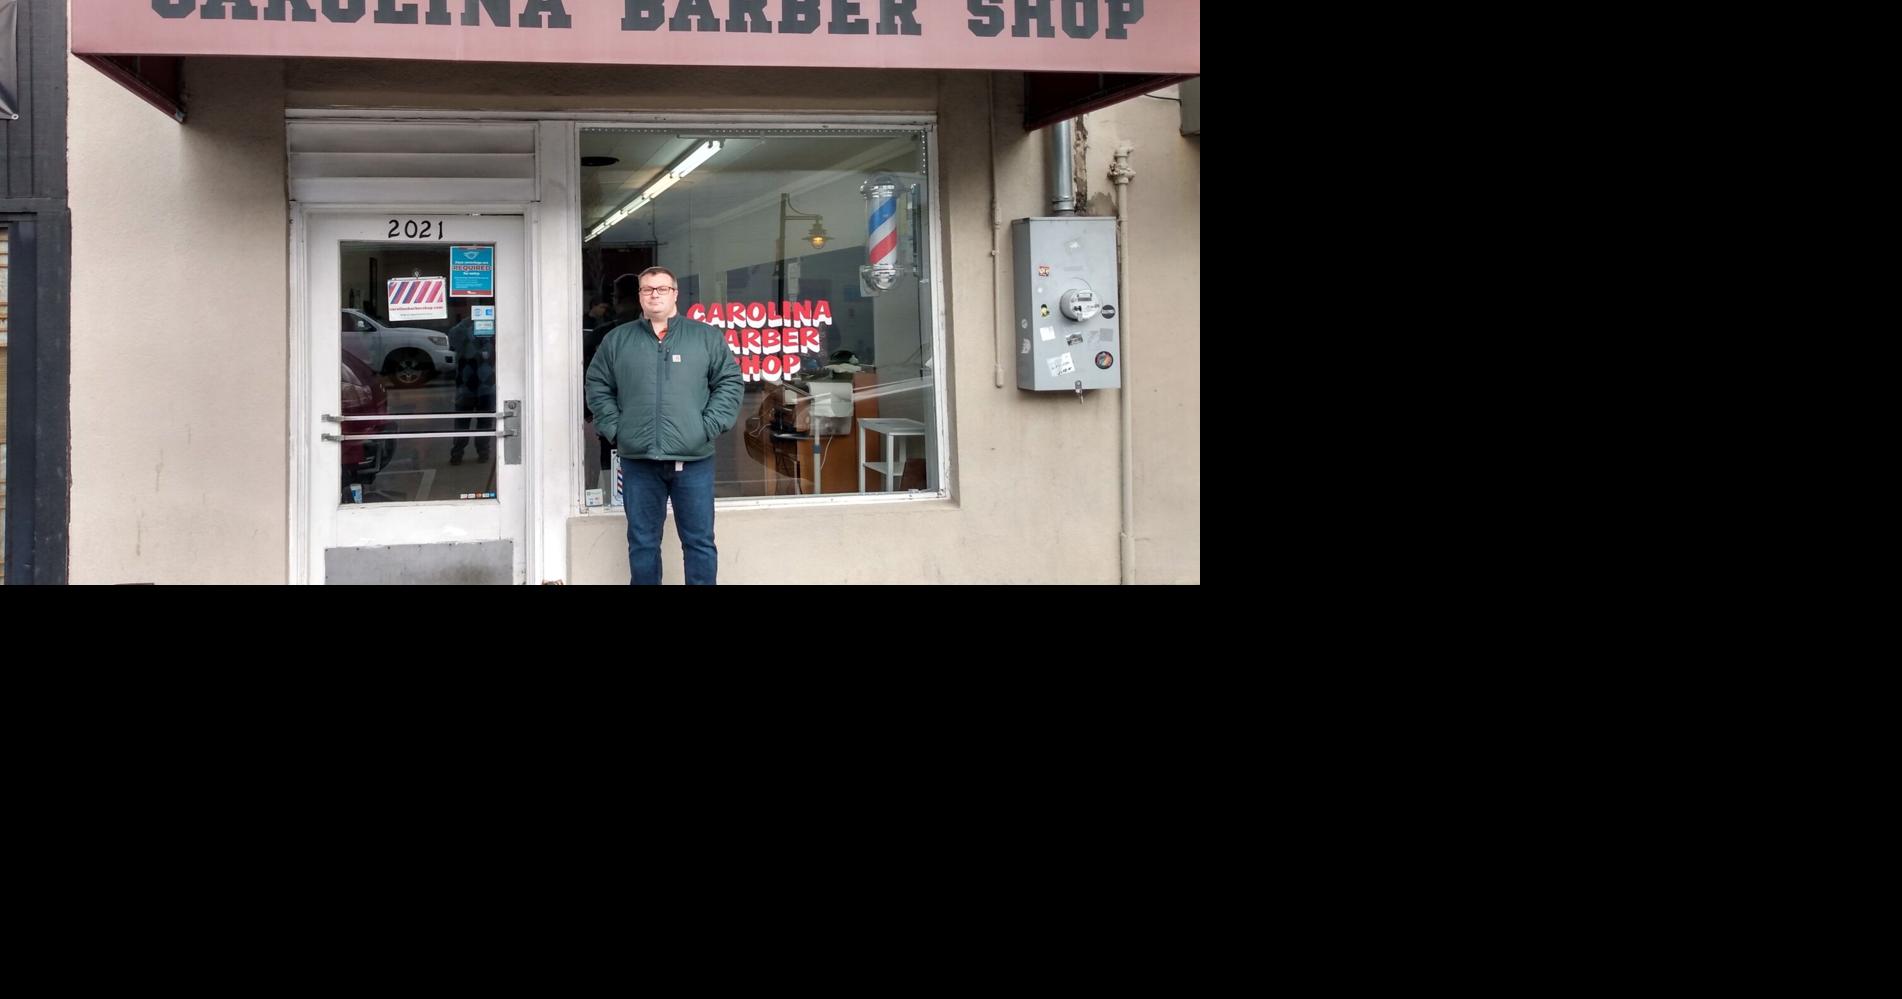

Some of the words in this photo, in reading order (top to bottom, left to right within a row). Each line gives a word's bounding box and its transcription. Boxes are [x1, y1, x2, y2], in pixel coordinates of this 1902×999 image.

[621, 0, 922, 35] BARBER
[966, 0, 1144, 39] SHOP
[388, 219, 443, 240] 2021
[687, 300, 832, 328] CAROLINA
[724, 327, 820, 355] ARBER
[737, 354, 801, 382] HOP
